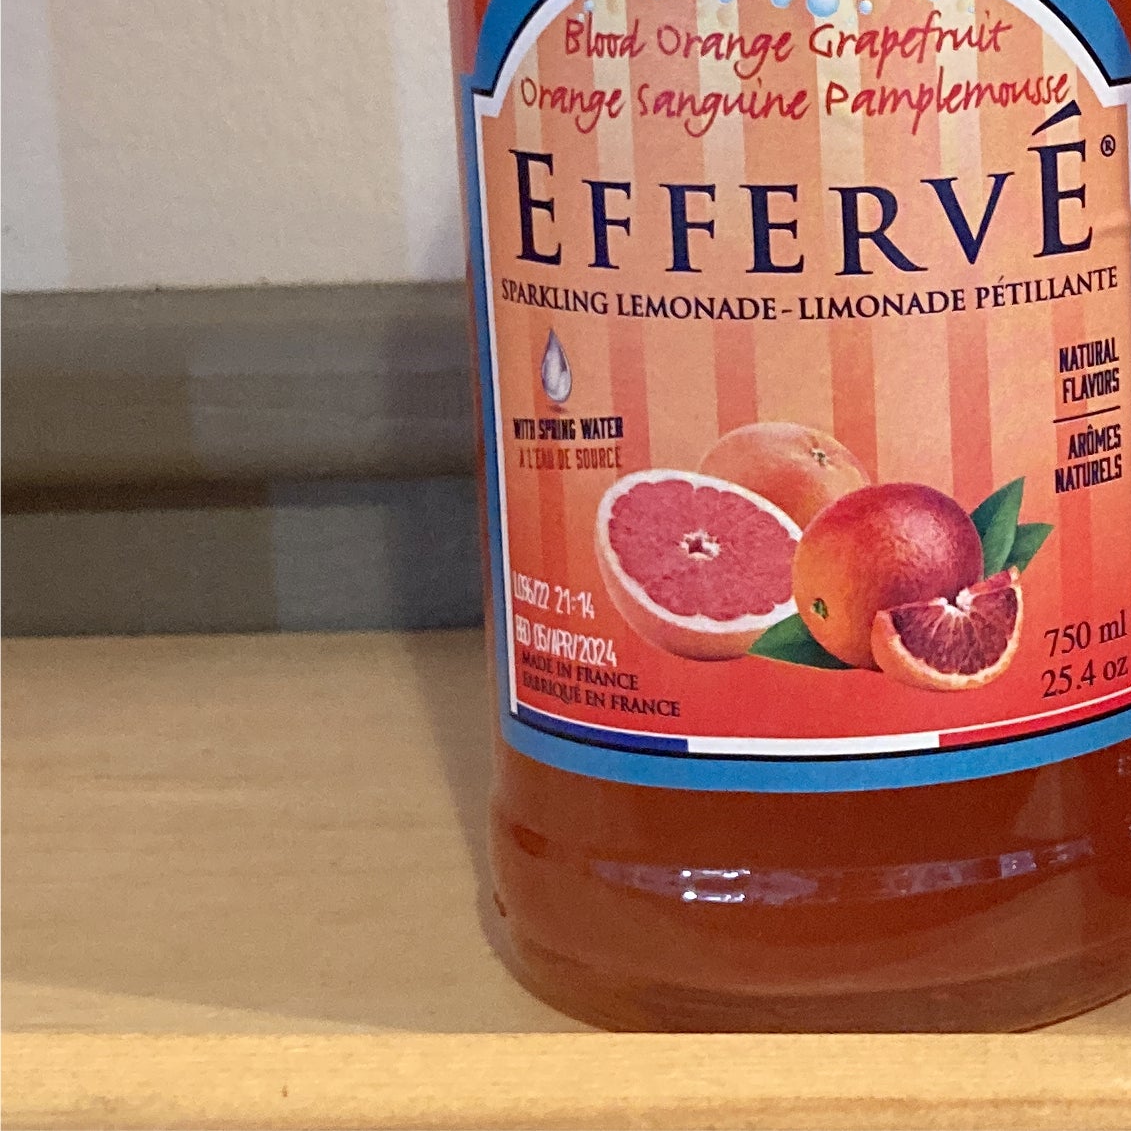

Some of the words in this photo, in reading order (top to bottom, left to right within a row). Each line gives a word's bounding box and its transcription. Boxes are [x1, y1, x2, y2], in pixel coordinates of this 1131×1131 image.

[563, 17, 643, 60] Blood
[656, 23, 794, 78] Orange
[808, 10, 1013, 72] Grapefruit
[520, 76, 625, 135] Orange
[638, 81, 811, 138] Sanguine
[824, 71, 1071, 135] Pamplemousse
[501, 277, 609, 316] SPARKLING
[616, 292, 778, 321] LEMONADE
[799, 288, 966, 320] LIMONADE
[975, 265, 1119, 310] PÉTILLANTE
[1059, 337, 1120, 373] NATURAL
[1062, 367, 1120, 404] FLAVORS
[580, 417, 624, 440] WATER
[1068, 423, 1121, 460] ARÔMES
[575, 445, 623, 470] SOURCE
[1054, 453, 1122, 494] NATURELS
[554, 585, 596, 620] 21:14
[1043, 621, 1092, 658] 750
[1099, 610, 1128, 644] ml
[556, 661, 572, 679] IN
[576, 667, 639, 691] FRANCE
[1041, 658, 1097, 699] 25.4
[1102, 656, 1129, 681] oz
[586, 689, 606, 708] EN
[610, 694, 681, 718] FRANCE
